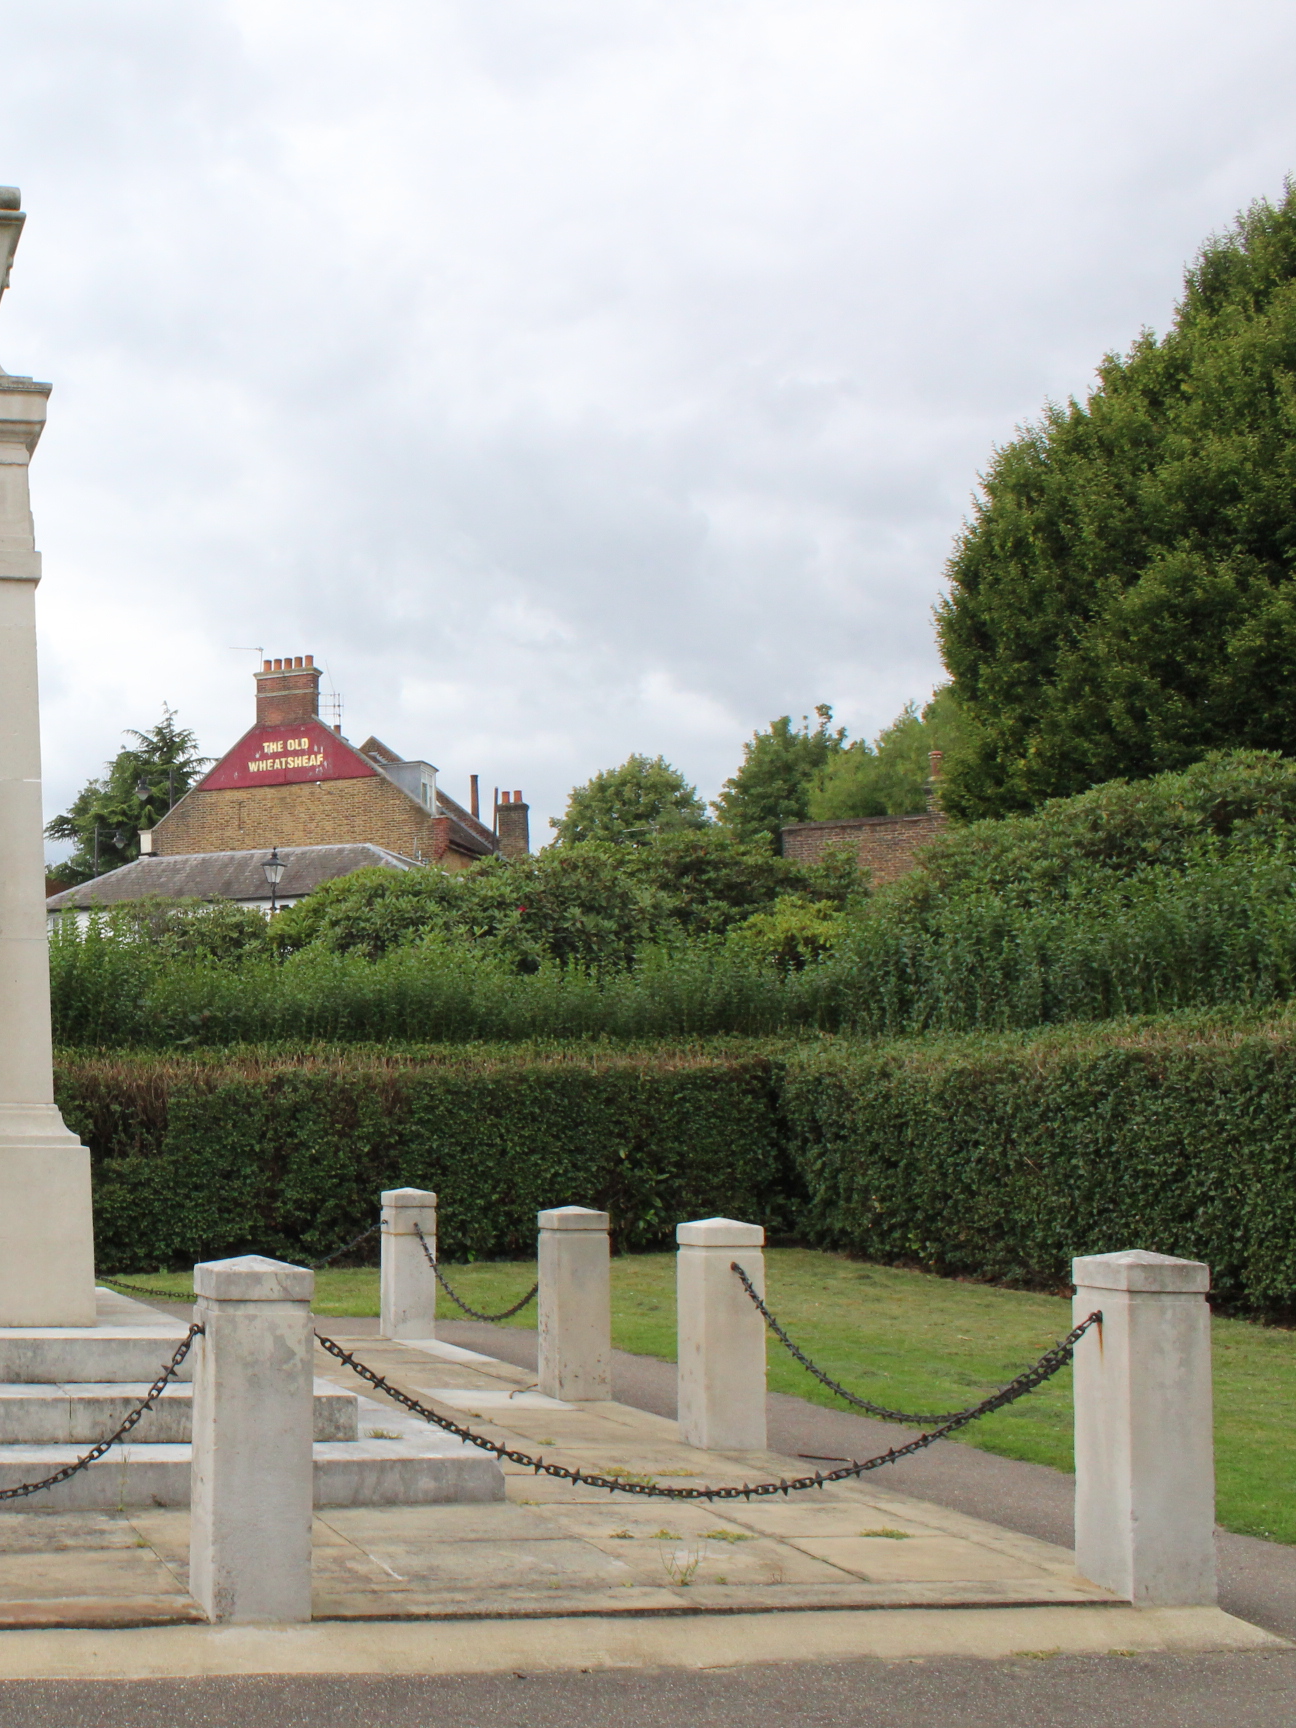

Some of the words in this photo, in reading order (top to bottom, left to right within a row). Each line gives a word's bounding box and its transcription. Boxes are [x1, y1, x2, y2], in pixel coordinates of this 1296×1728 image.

[262, 740, 284, 754] THE
[286, 737, 309, 751] OLD
[247, 753, 324, 773] WHEATSHEAF
